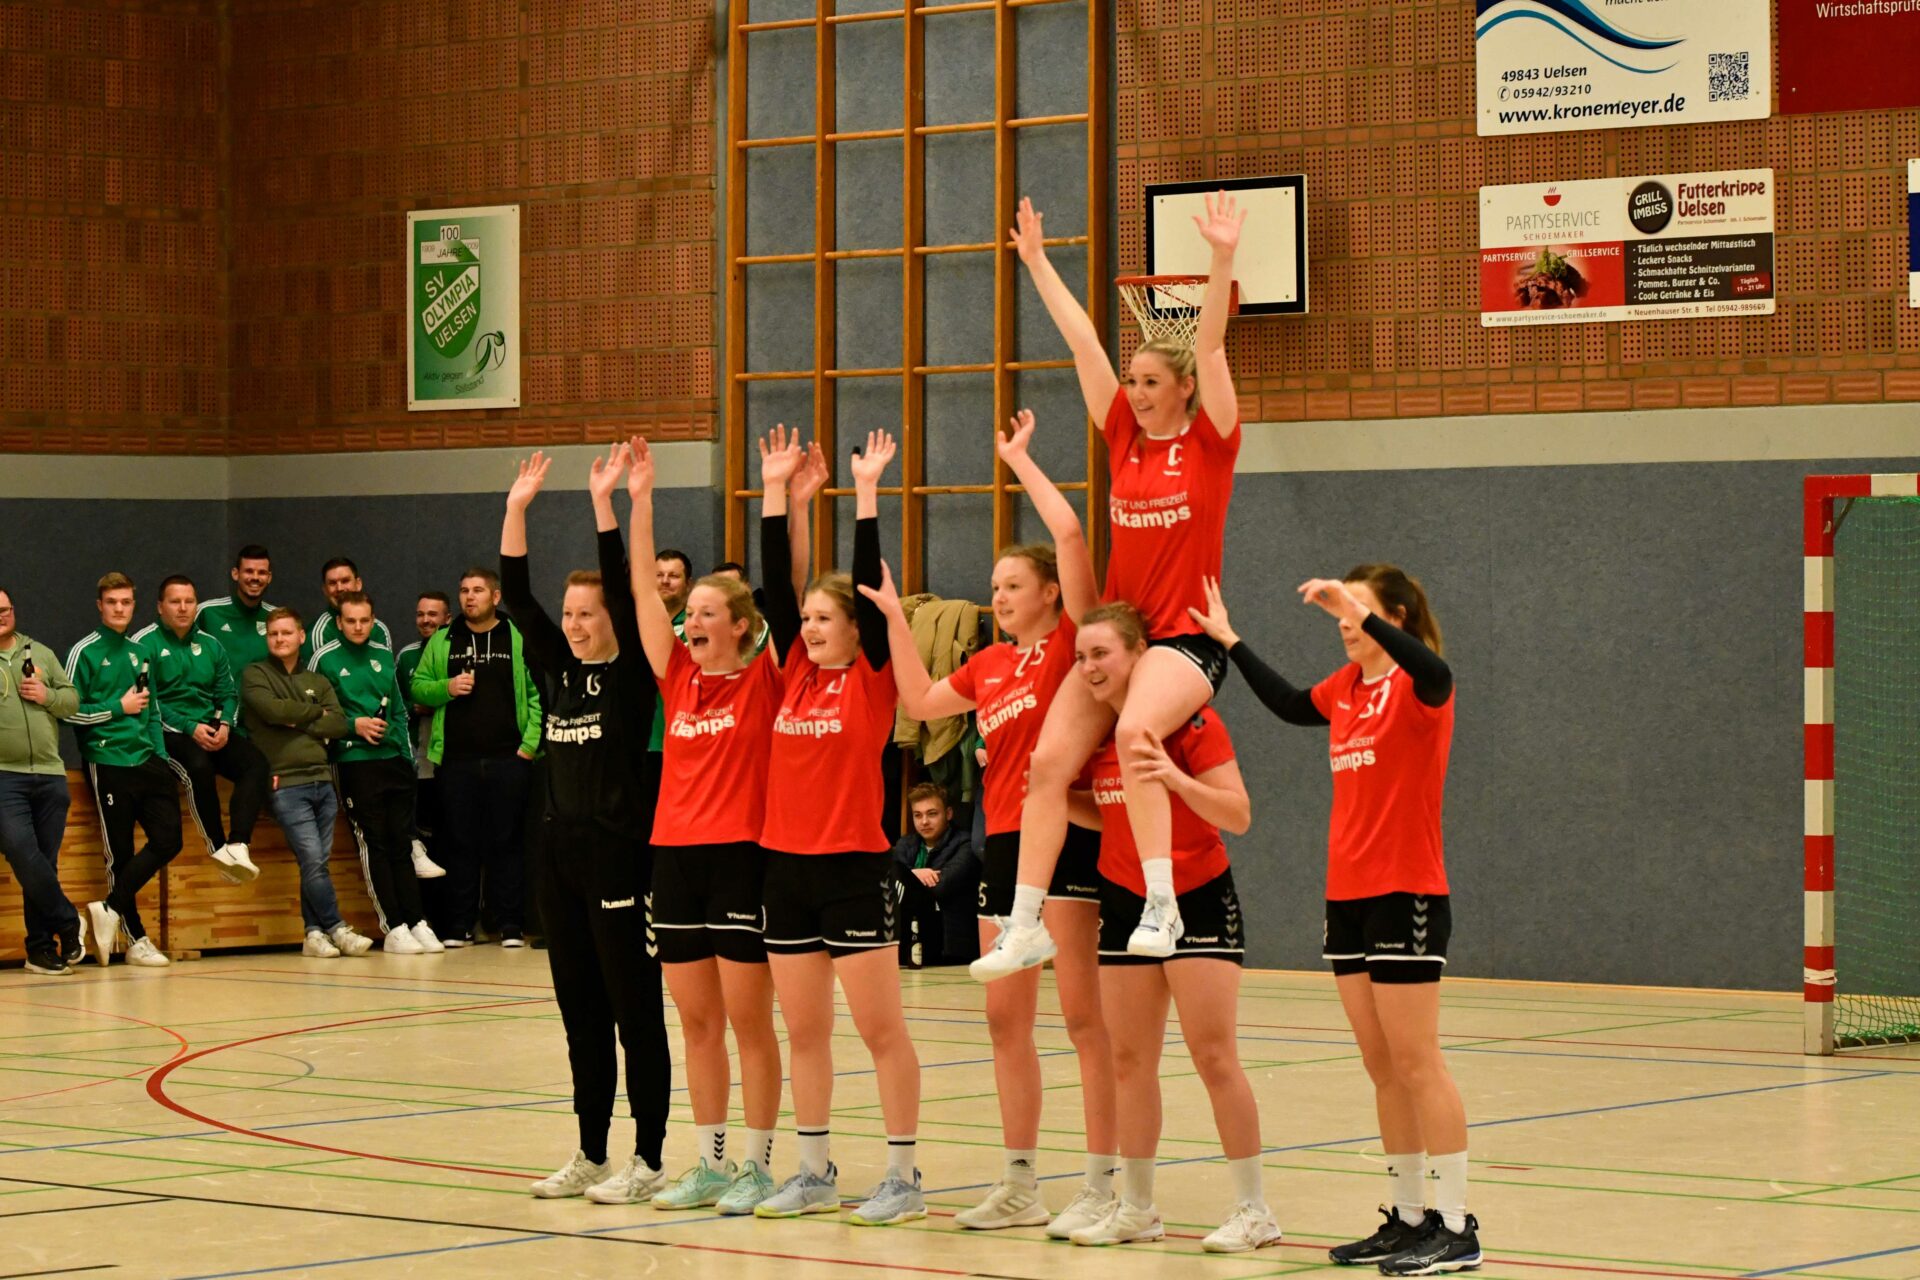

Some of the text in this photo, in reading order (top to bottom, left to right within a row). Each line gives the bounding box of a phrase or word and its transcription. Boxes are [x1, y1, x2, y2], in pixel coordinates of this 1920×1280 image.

[1501, 66, 1587, 82] 49843 Uelsen
[1513, 84, 1592, 99] 05942/93210
[1499, 94, 1686, 123] www.kronemeyer.de
[1678, 180, 1765, 199] Futterkrippe
[1635, 190, 1663, 206] GRILL
[1633, 202, 1668, 220] IMBISS
[1678, 200, 1725, 217] Uelsen
[1506, 210, 1601, 231] PARTYSERVICE
[441, 227, 459, 240] 100
[1523, 231, 1584, 241] SCHOEMAKER
[437, 247, 463, 258] JAHRE
[1566, 247, 1620, 258] GRILLSERVICE
[1637, 239, 1756, 253] Täglich wechselnder Mittagstisch
[1483, 251, 1537, 263] PARTYSERVICE
[1637, 254, 1692, 265] Leckere Snacks
[1638, 263, 1755, 277] Schmackhafte Schnitzelvarianten
[425, 270, 445, 299] SV
[1672, 278, 1697, 287] Burger
[1699, 277, 1706, 286] &
[1708, 276, 1720, 285] Co.
[424, 273, 476, 329] OLYMPIA
[1638, 288, 1714, 301] Coole Getränke & Eis
[1496, 311, 1607, 323] www.partyservice-schoemaker.de
[1634, 307, 1680, 316] Neuenhauser
[1682, 306, 1693, 314] Str.
[1706, 305, 1715, 313] Tel
[435, 302, 477, 349] UELSEN
[107, 793, 114, 806] 3
[346, 797, 354, 808] 9
[1093, 790, 1127, 806] kam
[601, 897, 635, 909] hummel
